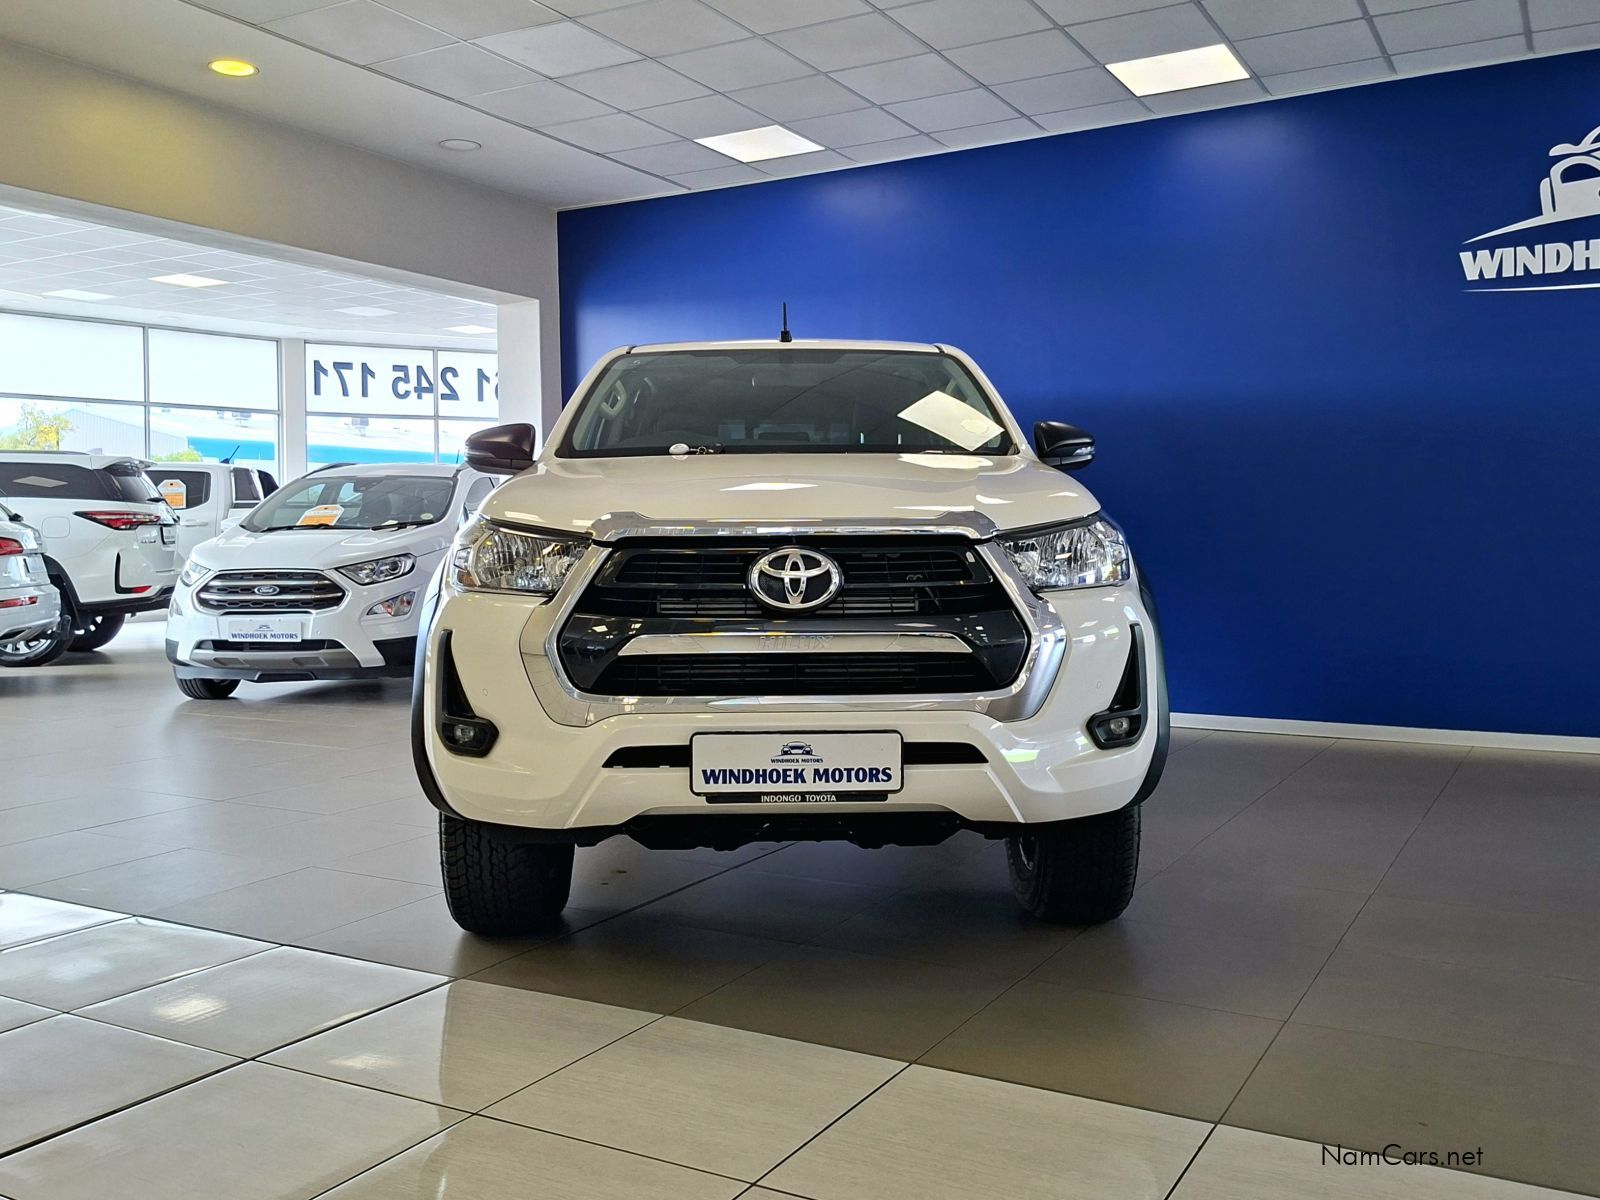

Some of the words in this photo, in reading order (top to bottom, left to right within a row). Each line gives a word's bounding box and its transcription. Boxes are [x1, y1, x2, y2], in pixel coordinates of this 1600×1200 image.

[231, 632, 268, 640] WINDHOEK
[269, 632, 298, 640] MOTORS
[702, 767, 807, 785] WINDHOEK
[812, 766, 893, 783] MOTORS
[760, 794, 801, 803] INDONGO
[805, 794, 837, 802] TOYOTA
